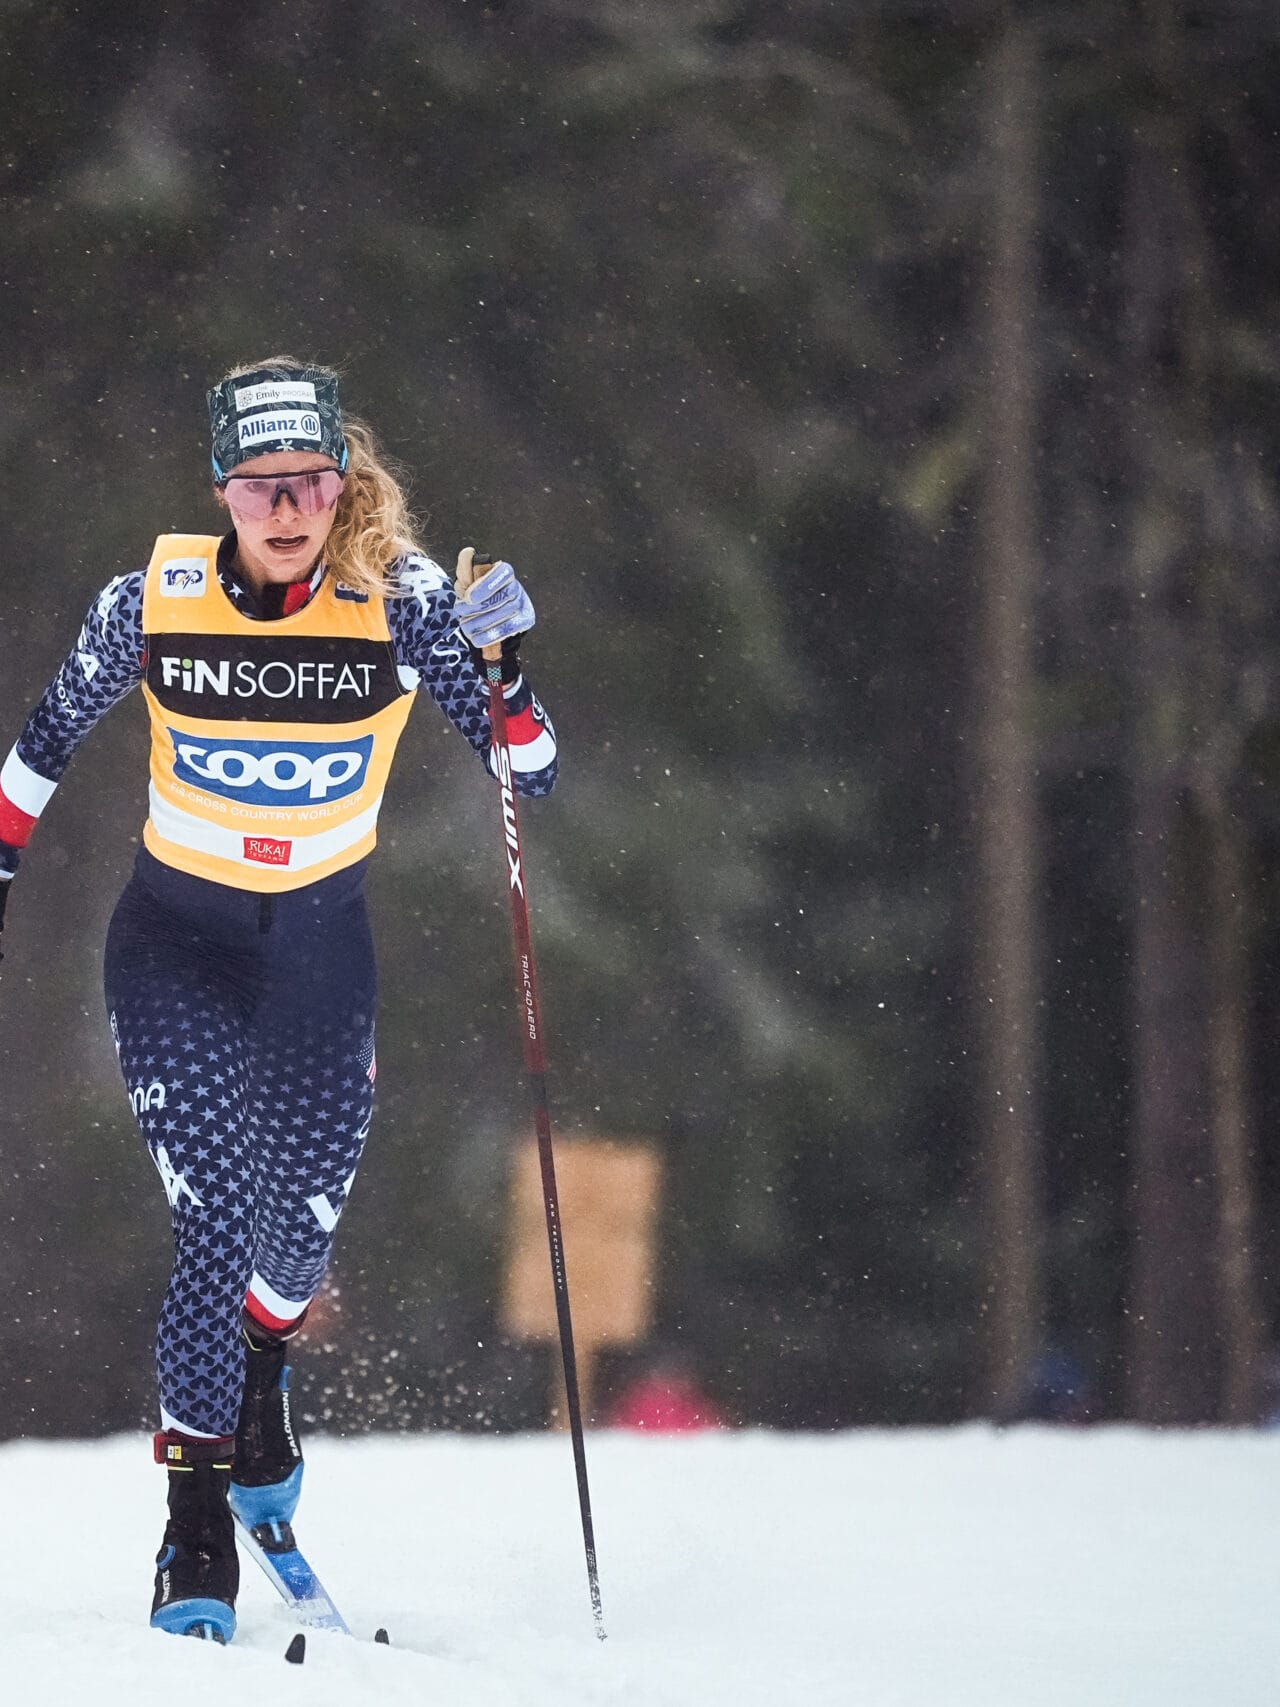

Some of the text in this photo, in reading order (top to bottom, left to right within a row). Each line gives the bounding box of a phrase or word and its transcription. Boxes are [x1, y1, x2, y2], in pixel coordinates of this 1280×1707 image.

[256, 390, 280, 400] Emily
[240, 419, 297, 440] Allianz
[187, 792, 227, 813] CROSS
[230, 806, 294, 821] COUNTRY
[297, 806, 341, 821] WORLD
[343, 793, 365, 810] CUP
[521, 953, 531, 988] TRIAC
[527, 1006, 537, 1040] AERO
[552, 1225, 563, 1290] TECHNOLOGY
[282, 1391, 300, 1457] SALOMON
